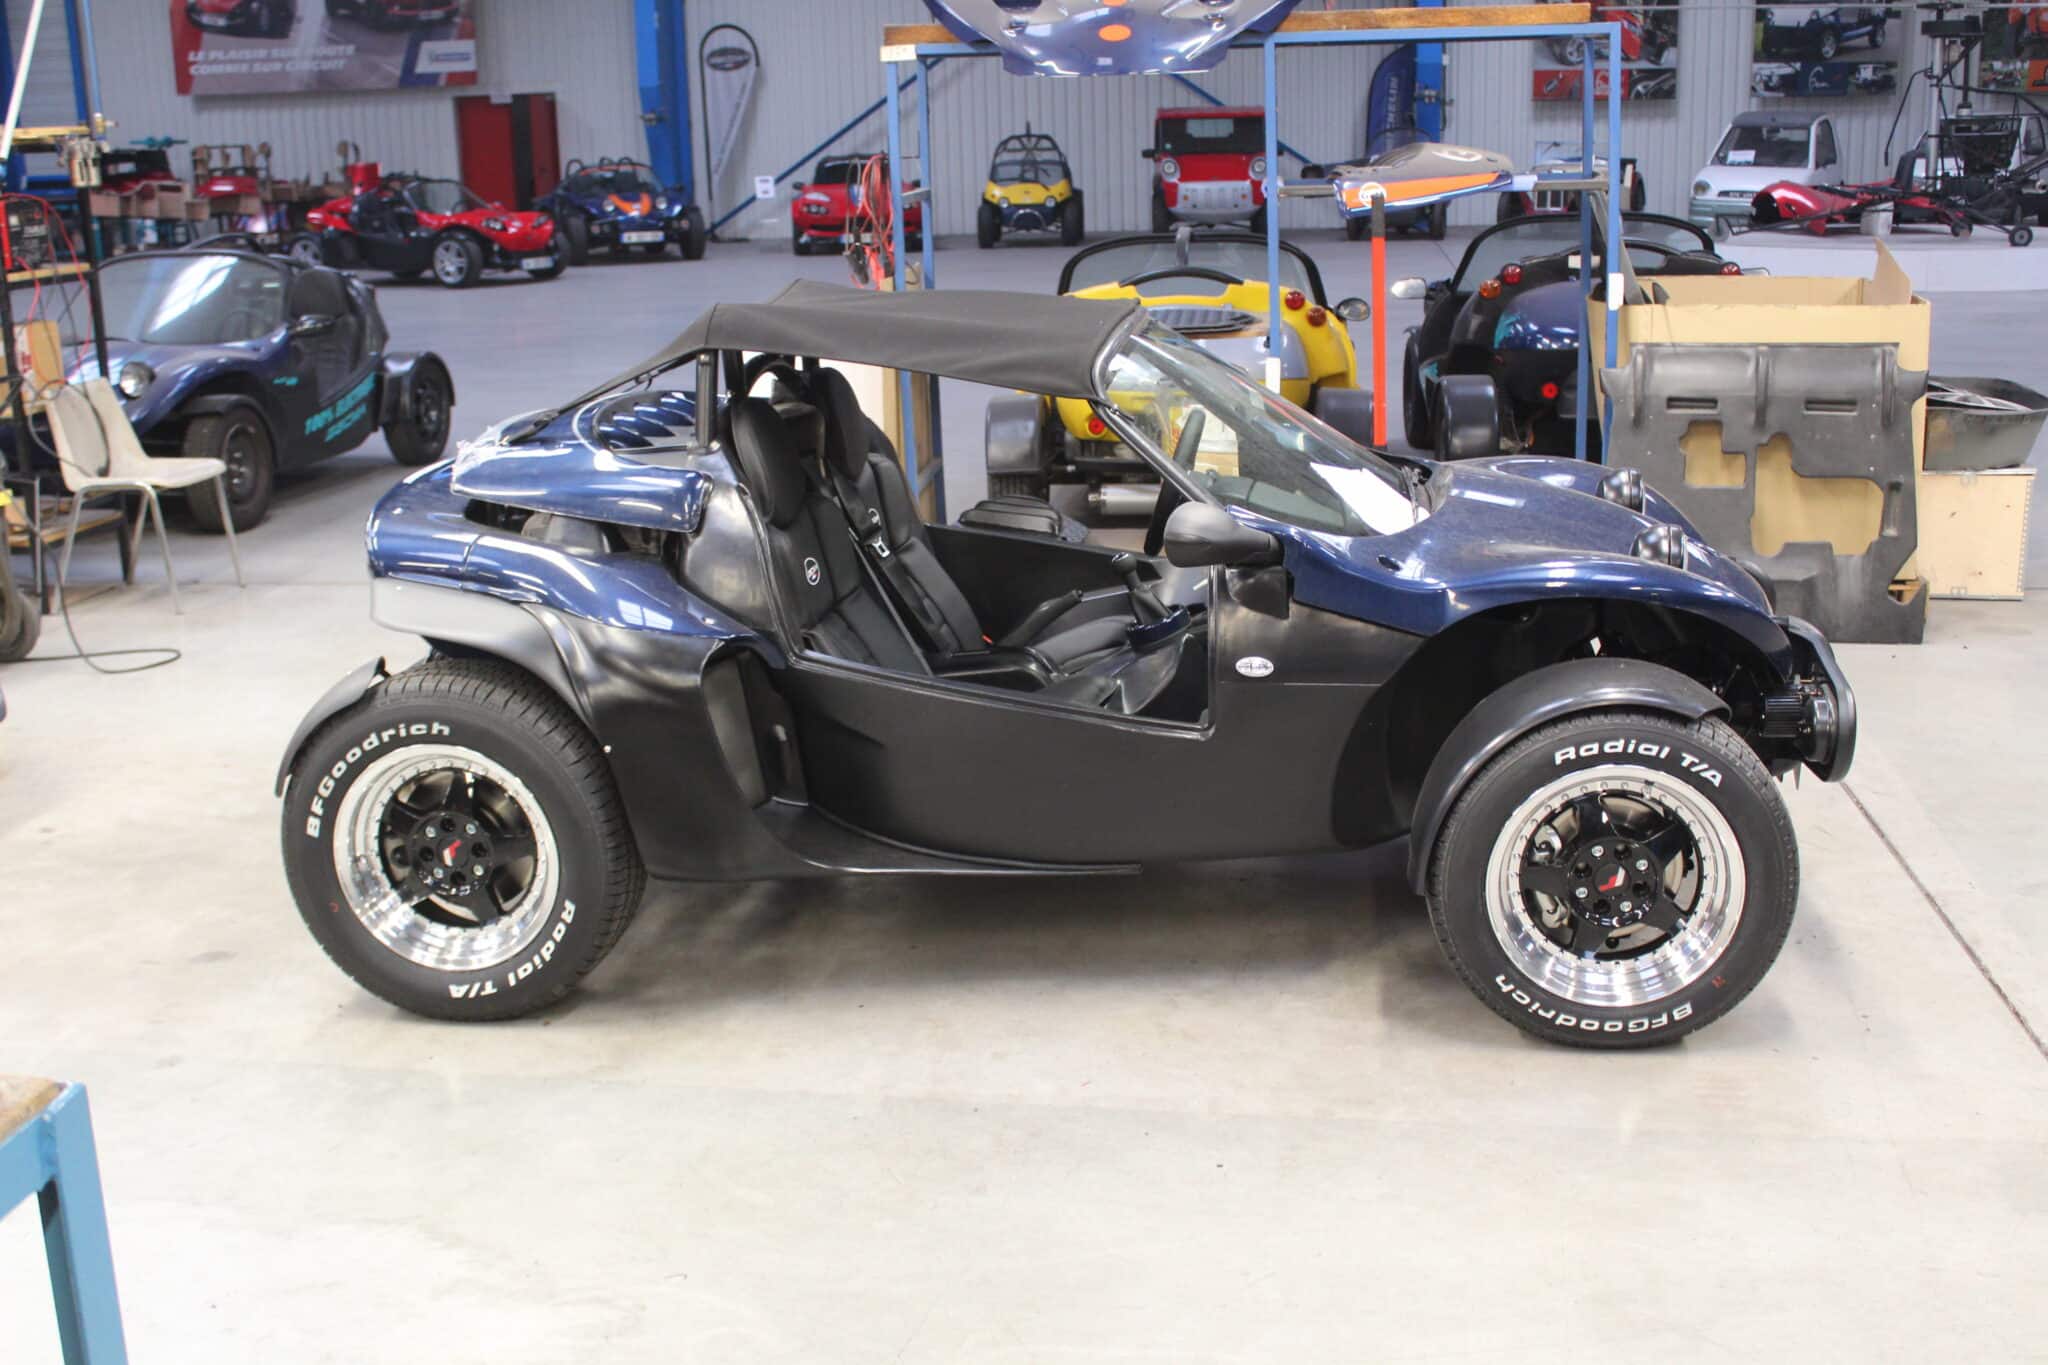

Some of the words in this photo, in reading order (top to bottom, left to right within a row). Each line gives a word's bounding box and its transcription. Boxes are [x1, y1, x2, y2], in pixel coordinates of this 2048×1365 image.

[306, 720, 451, 839] BFGoodrich
[1553, 738, 1671, 766] Radial
[1680, 752, 1724, 788] T/A
[507, 899, 577, 987] Radial
[448, 979, 499, 999] T/A
[1495, 974, 1694, 1033] BFGoodrich
